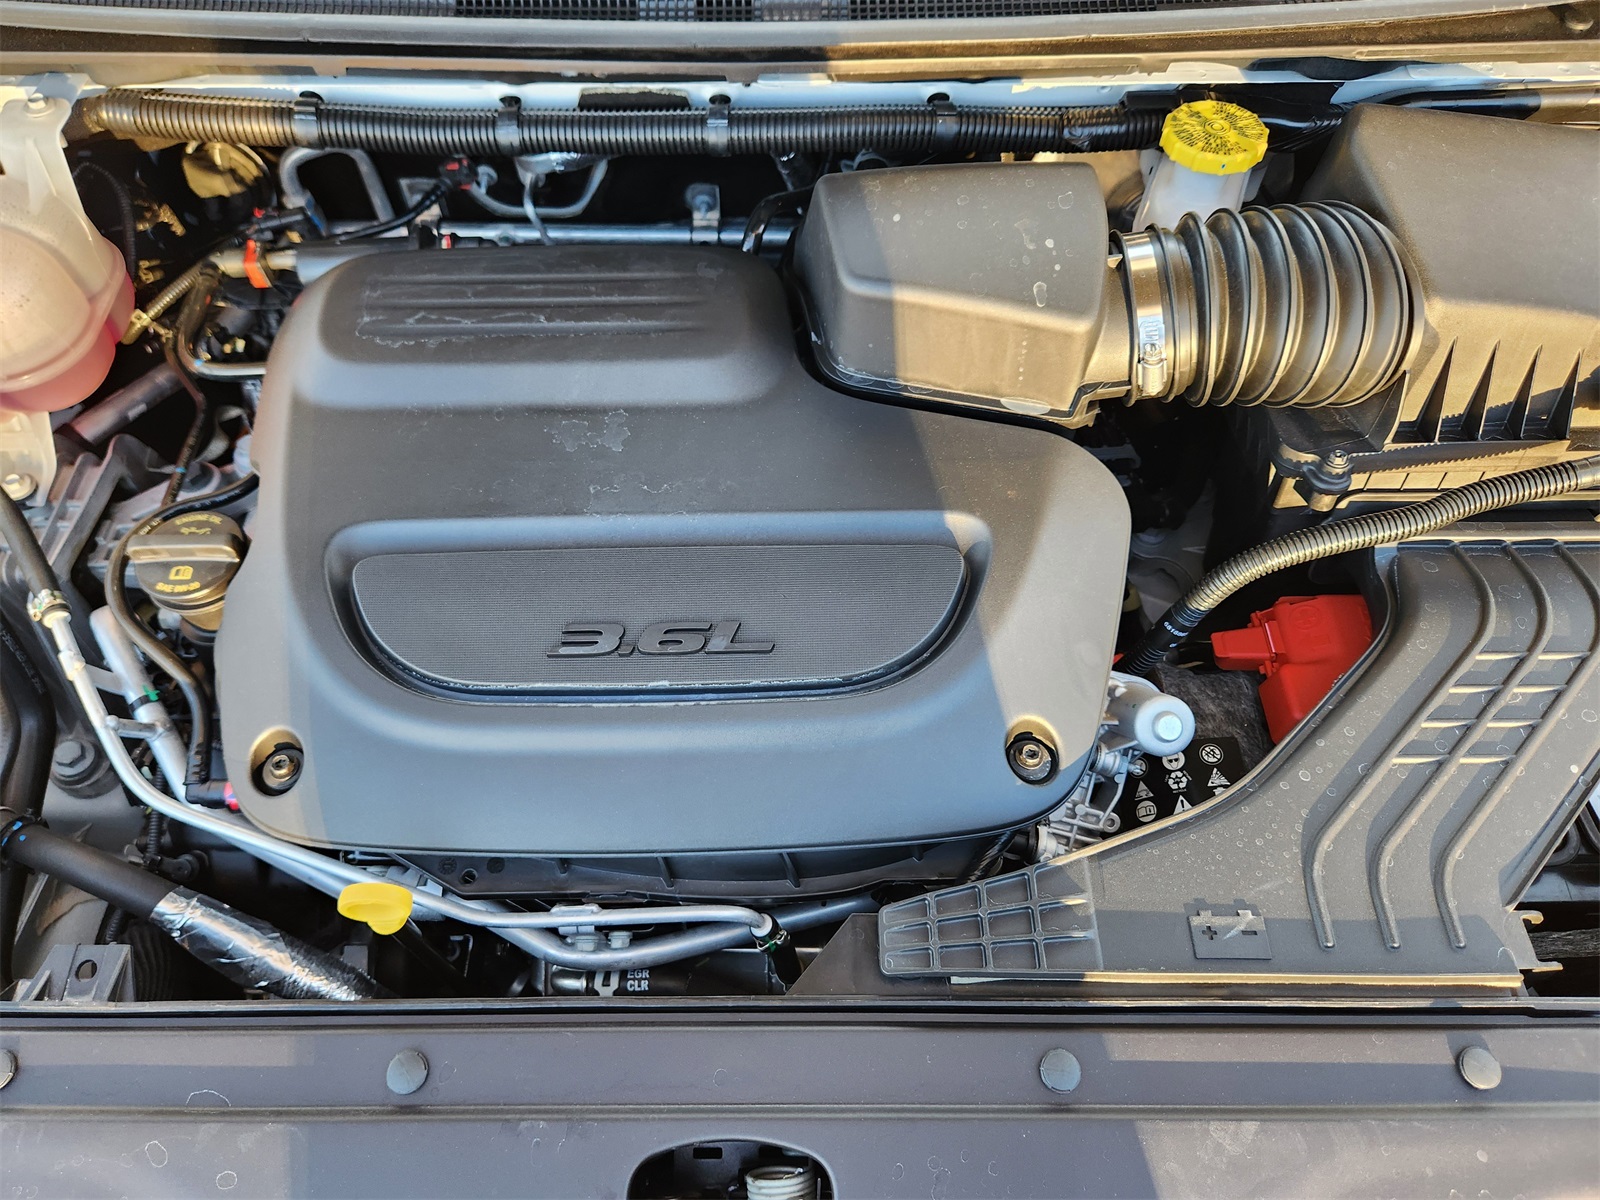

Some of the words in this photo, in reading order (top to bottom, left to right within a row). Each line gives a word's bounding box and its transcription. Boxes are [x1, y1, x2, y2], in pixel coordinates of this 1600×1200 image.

[155, 582, 174, 593] SAE
[547, 620, 776, 658] 3.6L
[627, 969, 650, 979] EGR
[627, 979, 649, 991] CLR
